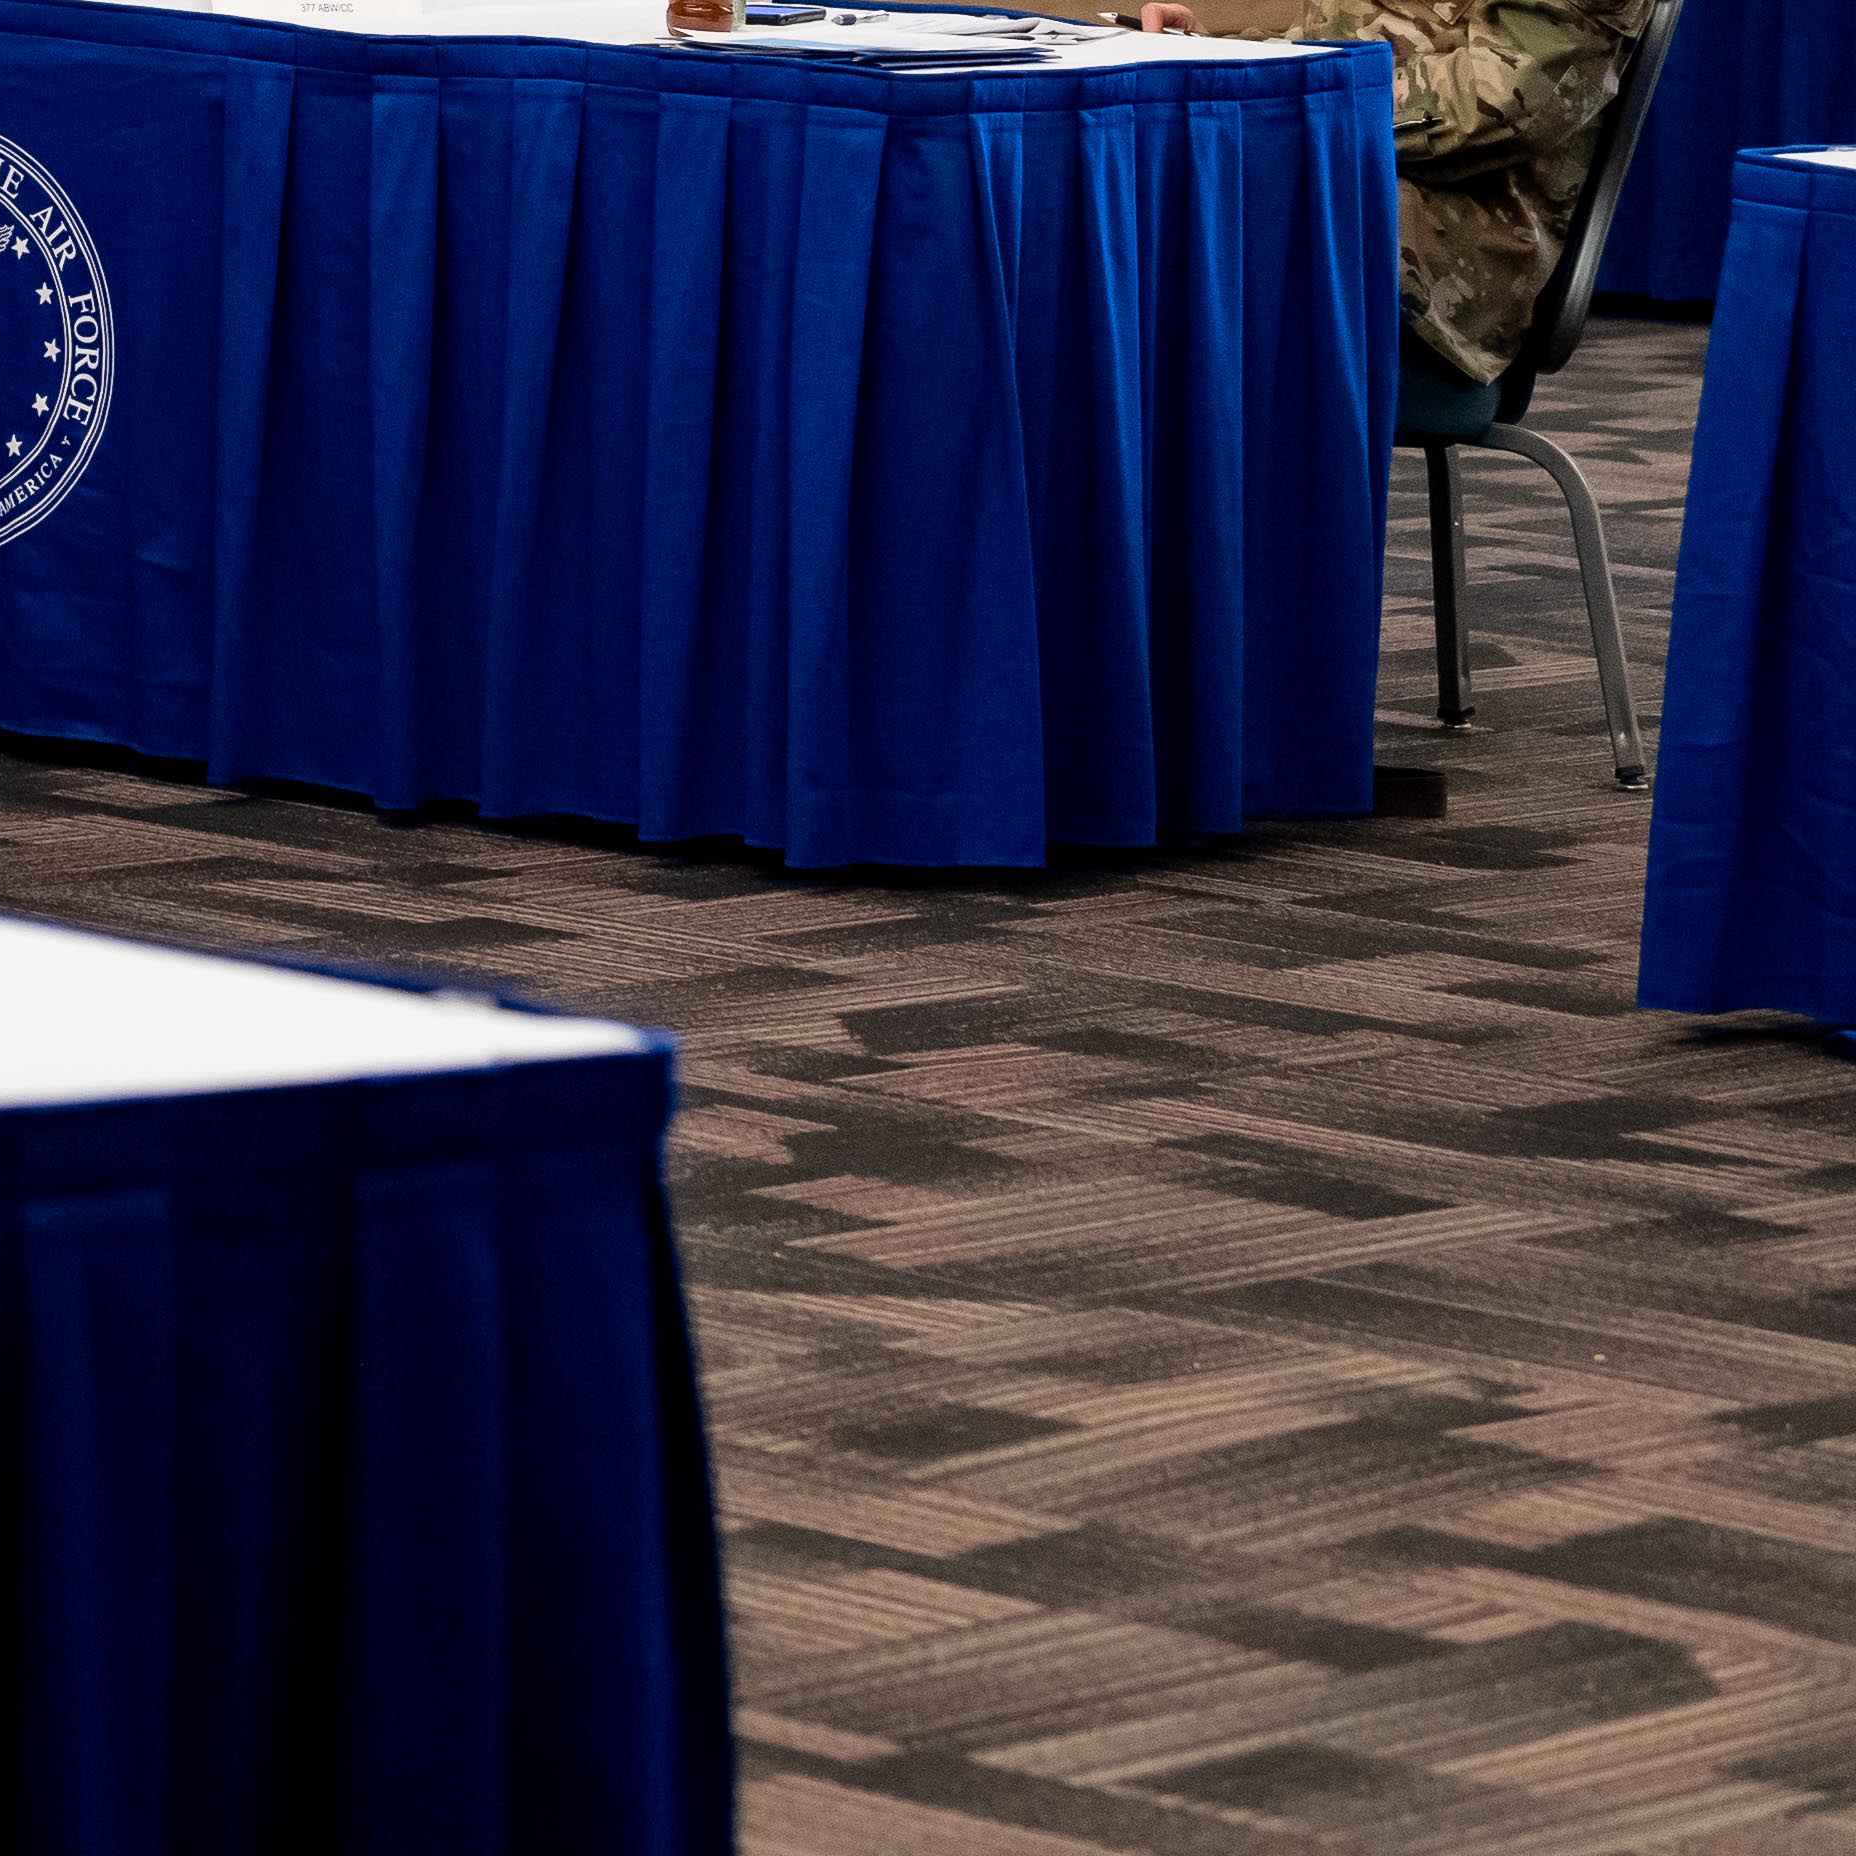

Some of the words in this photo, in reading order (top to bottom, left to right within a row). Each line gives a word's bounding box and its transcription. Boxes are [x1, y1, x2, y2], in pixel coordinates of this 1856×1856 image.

[300, 3, 316, 13] 377
[30, 205, 77, 271] AIR
[62, 290, 99, 427] FORCE
[0, 453, 64, 518] AMERICA
